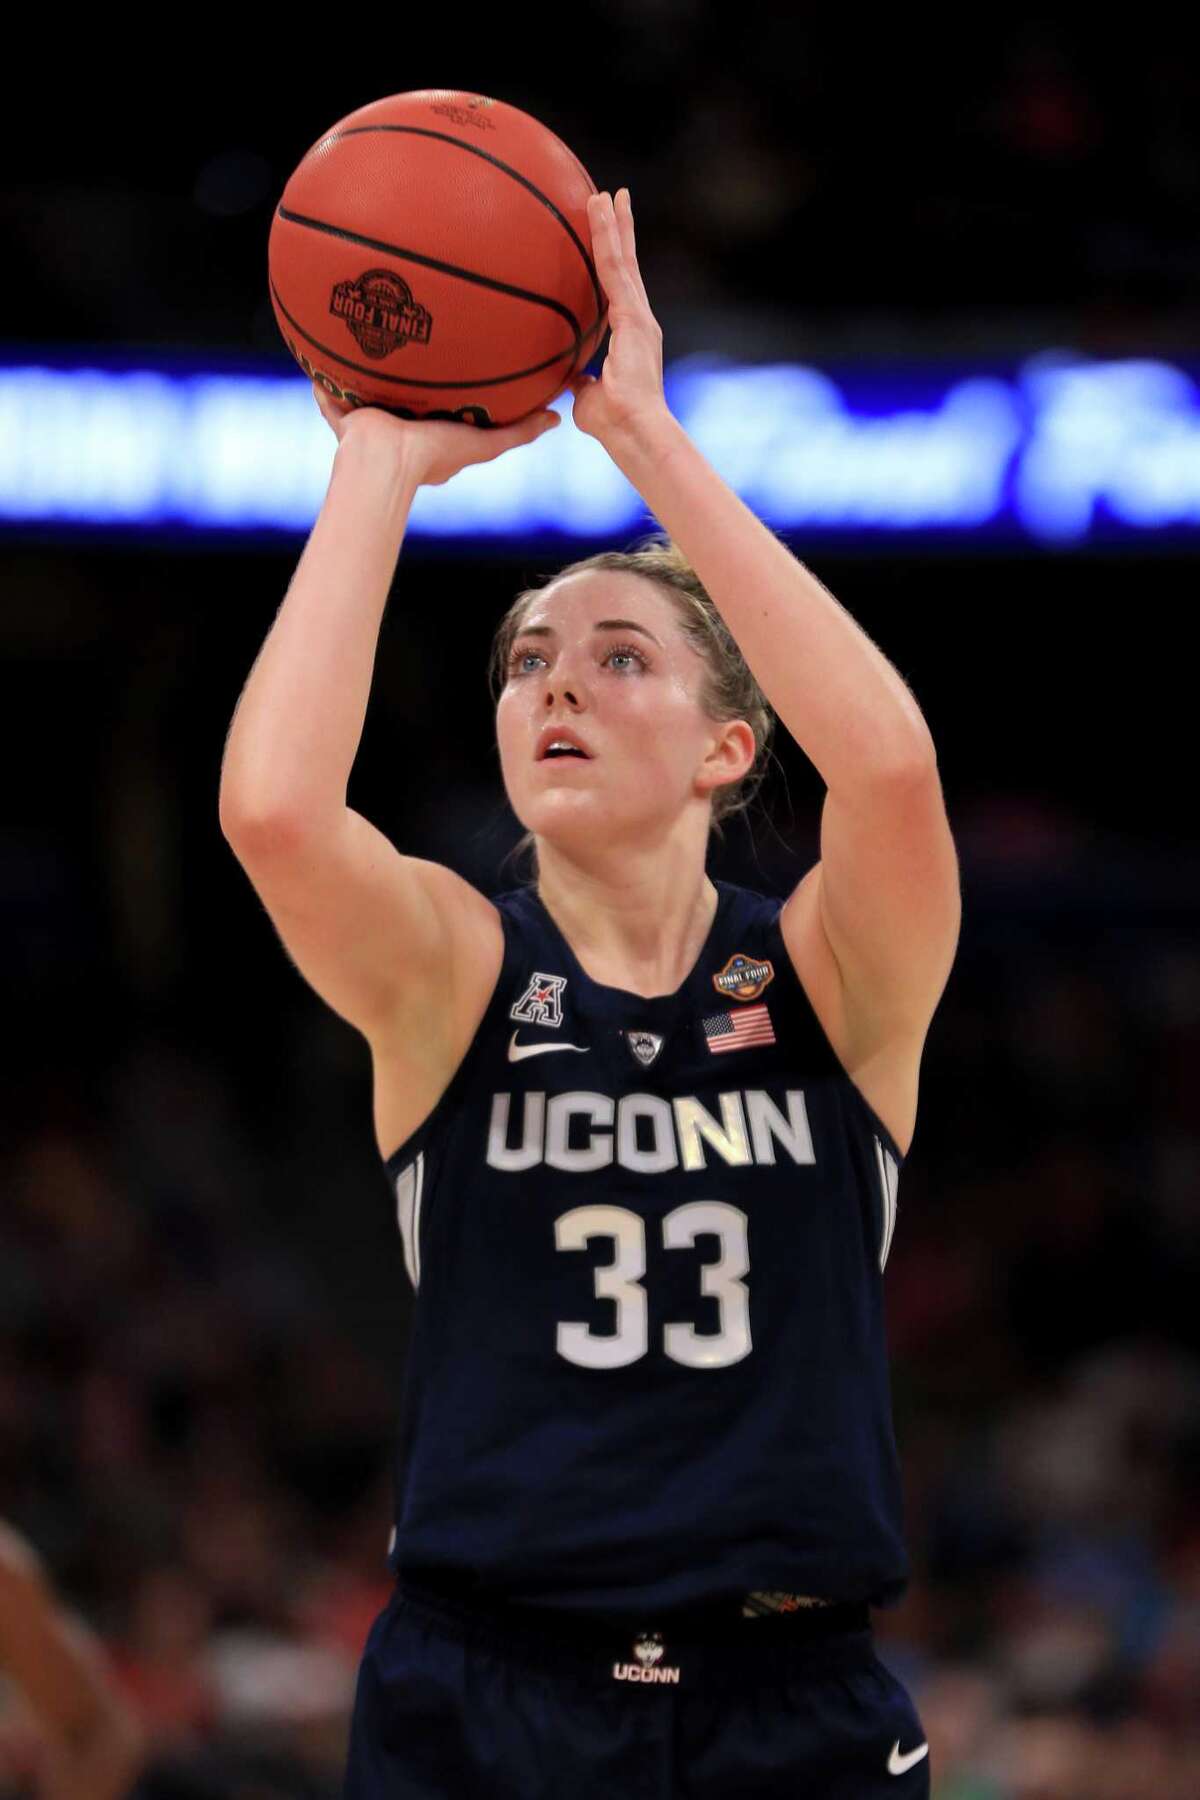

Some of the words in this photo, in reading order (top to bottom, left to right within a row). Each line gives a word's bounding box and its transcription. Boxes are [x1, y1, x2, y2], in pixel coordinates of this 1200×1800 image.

[334, 293, 375, 324] FOUR
[382, 309, 428, 337] FINAL
[718, 973, 743, 986] FINAL
[745, 966, 769, 979] FOUR
[509, 972, 568, 1028] A
[486, 1091, 816, 1173] UCONN
[554, 1201, 753, 1369] 33
[613, 1662, 680, 1684] UCONN
